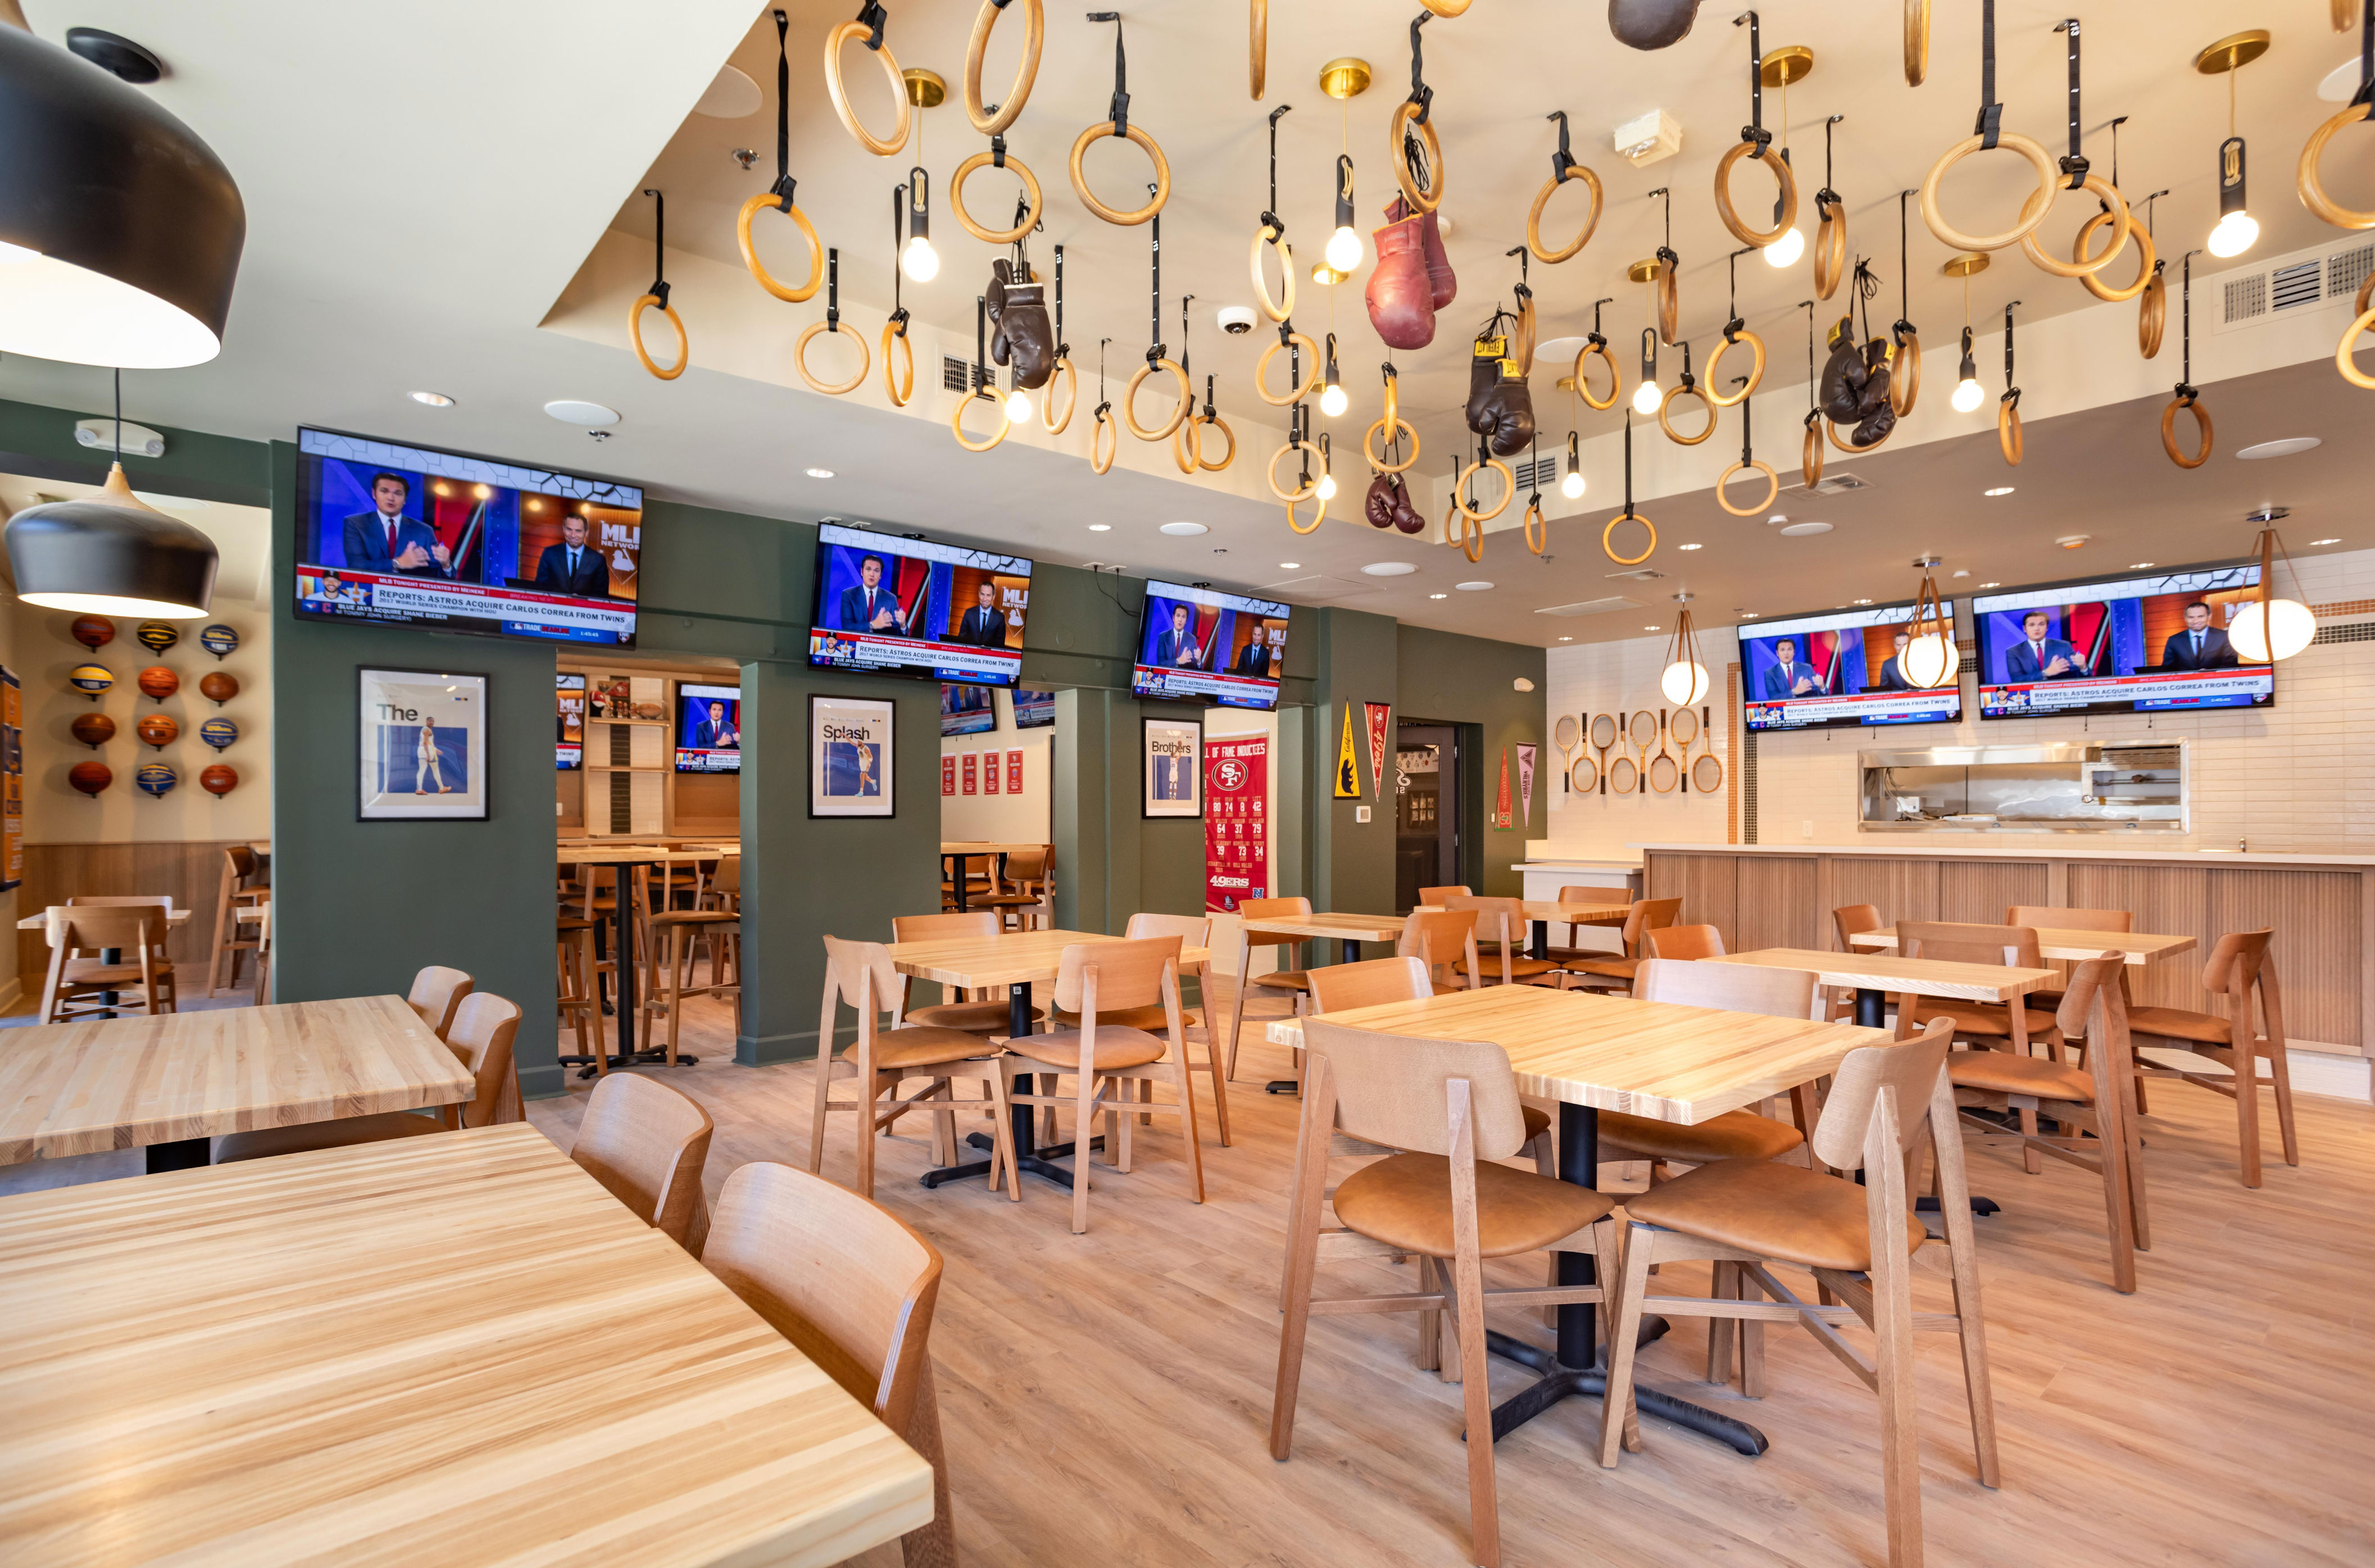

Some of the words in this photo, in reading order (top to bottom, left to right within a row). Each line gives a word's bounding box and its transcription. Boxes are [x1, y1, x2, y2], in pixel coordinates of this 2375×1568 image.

[601, 539, 639, 551] NETWOR
[419, 582, 451, 591] PRESENTED
[373, 607, 401, 615] ACQUIRE
[379, 589, 425, 602] REPORTS:
[428, 594, 463, 606] ASTROS
[465, 599, 503, 610] ACQUIRE
[506, 603, 539, 613] CARLOS
[541, 607, 574, 617] CORREA
[576, 611, 598, 620] FROM
[600, 613, 625, 622] TWINS
[523, 623, 541, 631] TRADE
[860, 646, 888, 654] REPORTS:
[889, 648, 911, 657] ASTROS
[376, 704, 418, 721] The
[823, 725, 869, 742] Splash
[1152, 741, 1191, 753] Brothers
[1212, 747, 1219, 758] OF
[1222, 746, 1236, 757] FAME
[1237, 743, 1265, 757] INDUCTEES
[1374, 730, 1383, 770] 49ers
[1213, 802, 1221, 812] 80
[1225, 802, 1233, 812] 74
[1240, 802, 1245, 812] 8
[1252, 801, 1262, 811] 42
[1217, 824, 1225, 833] 64
[1234, 824, 1243, 834] 37
[1252, 824, 1262, 834] 79
[1216, 846, 1225, 855] 39
[1238, 846, 1246, 856] 73
[1255, 846, 1264, 856] 34
[1210, 875, 1250, 888] 49ERS
